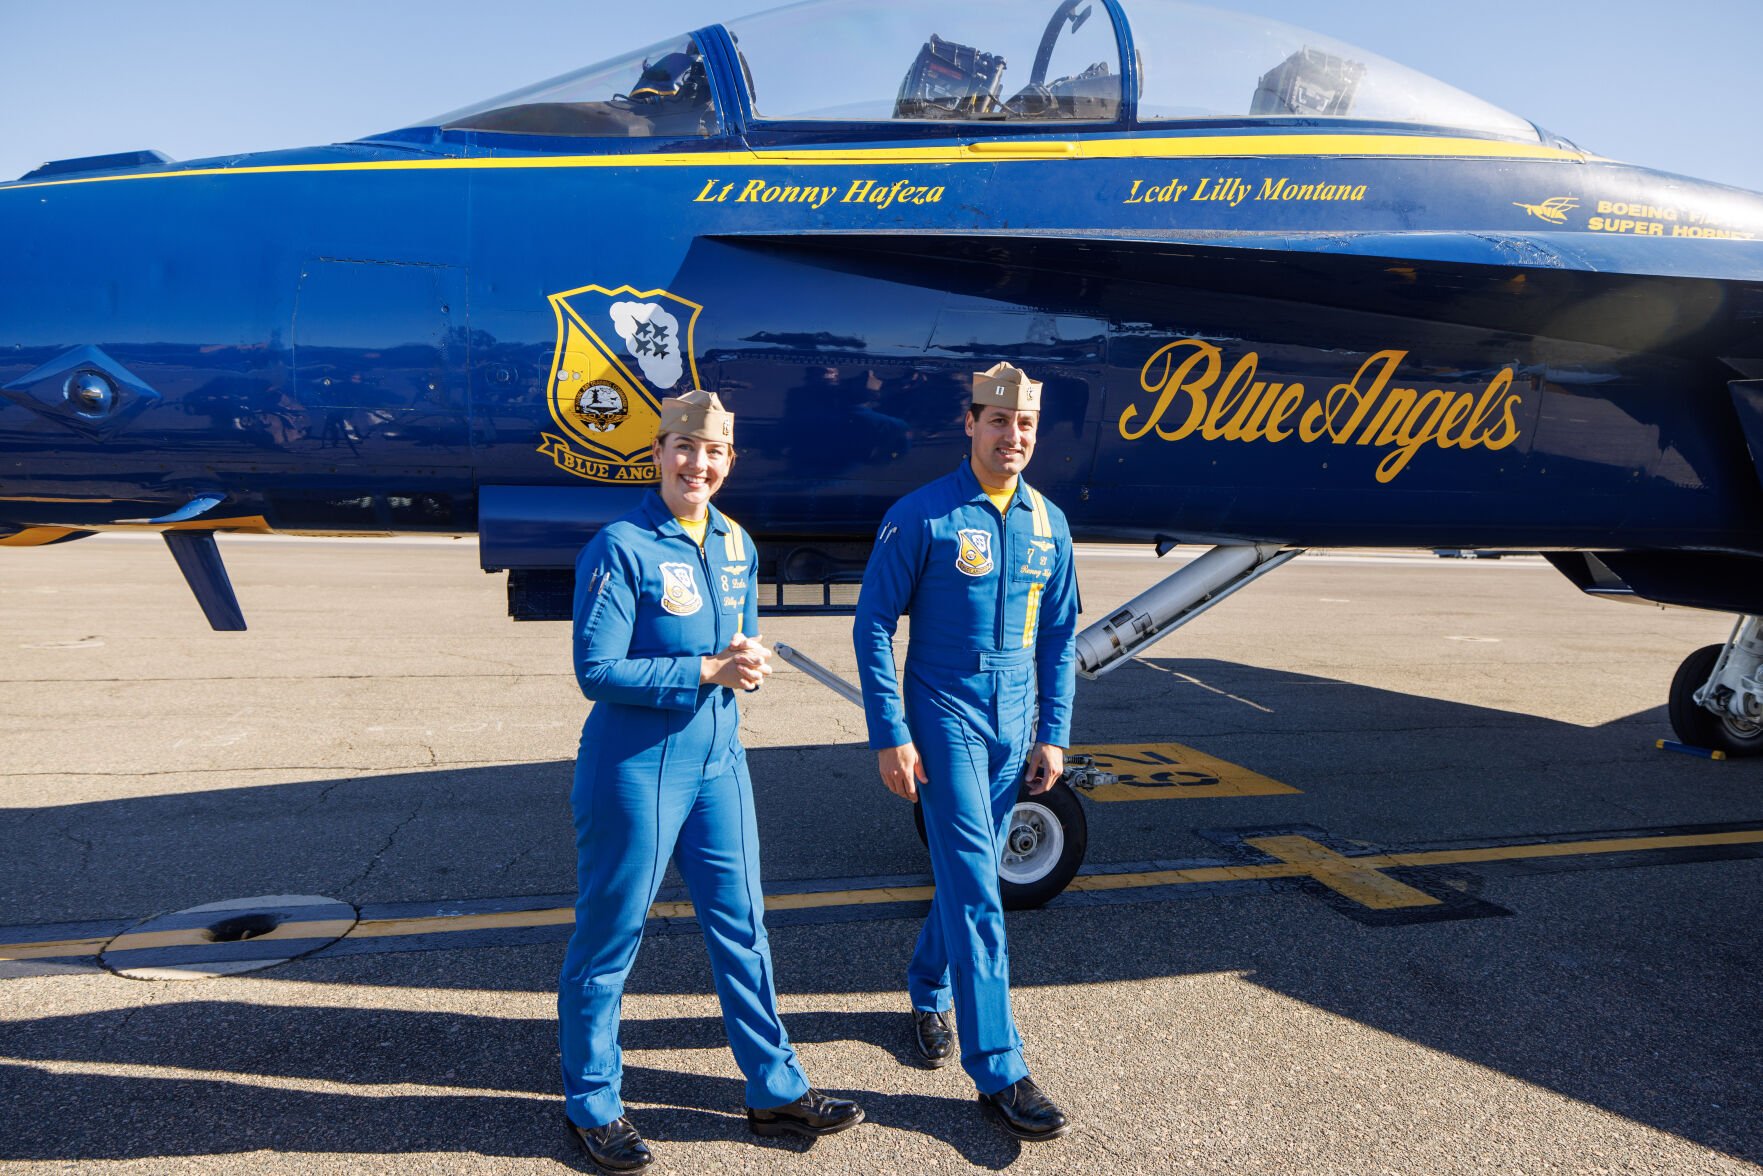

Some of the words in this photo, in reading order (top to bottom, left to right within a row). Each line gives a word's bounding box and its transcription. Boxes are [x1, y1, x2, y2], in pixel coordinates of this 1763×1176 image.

[692, 179, 734, 203] Lt
[735, 179, 837, 209] Ronny
[840, 179, 945, 209] Hafeza
[1123, 178, 1188, 204] Lcdr
[1190, 177, 1252, 207] Lilly
[1254, 177, 1368, 201] Montana
[1597, 200, 1678, 221] BOEING
[1587, 216, 1664, 237] SUPER
[1118, 338, 1304, 443] Blue
[1298, 349, 1522, 483] Angels
[563, 452, 609, 477] BLUE
[1027, 547, 1035, 564] 7
[720, 574, 729, 592] 8
